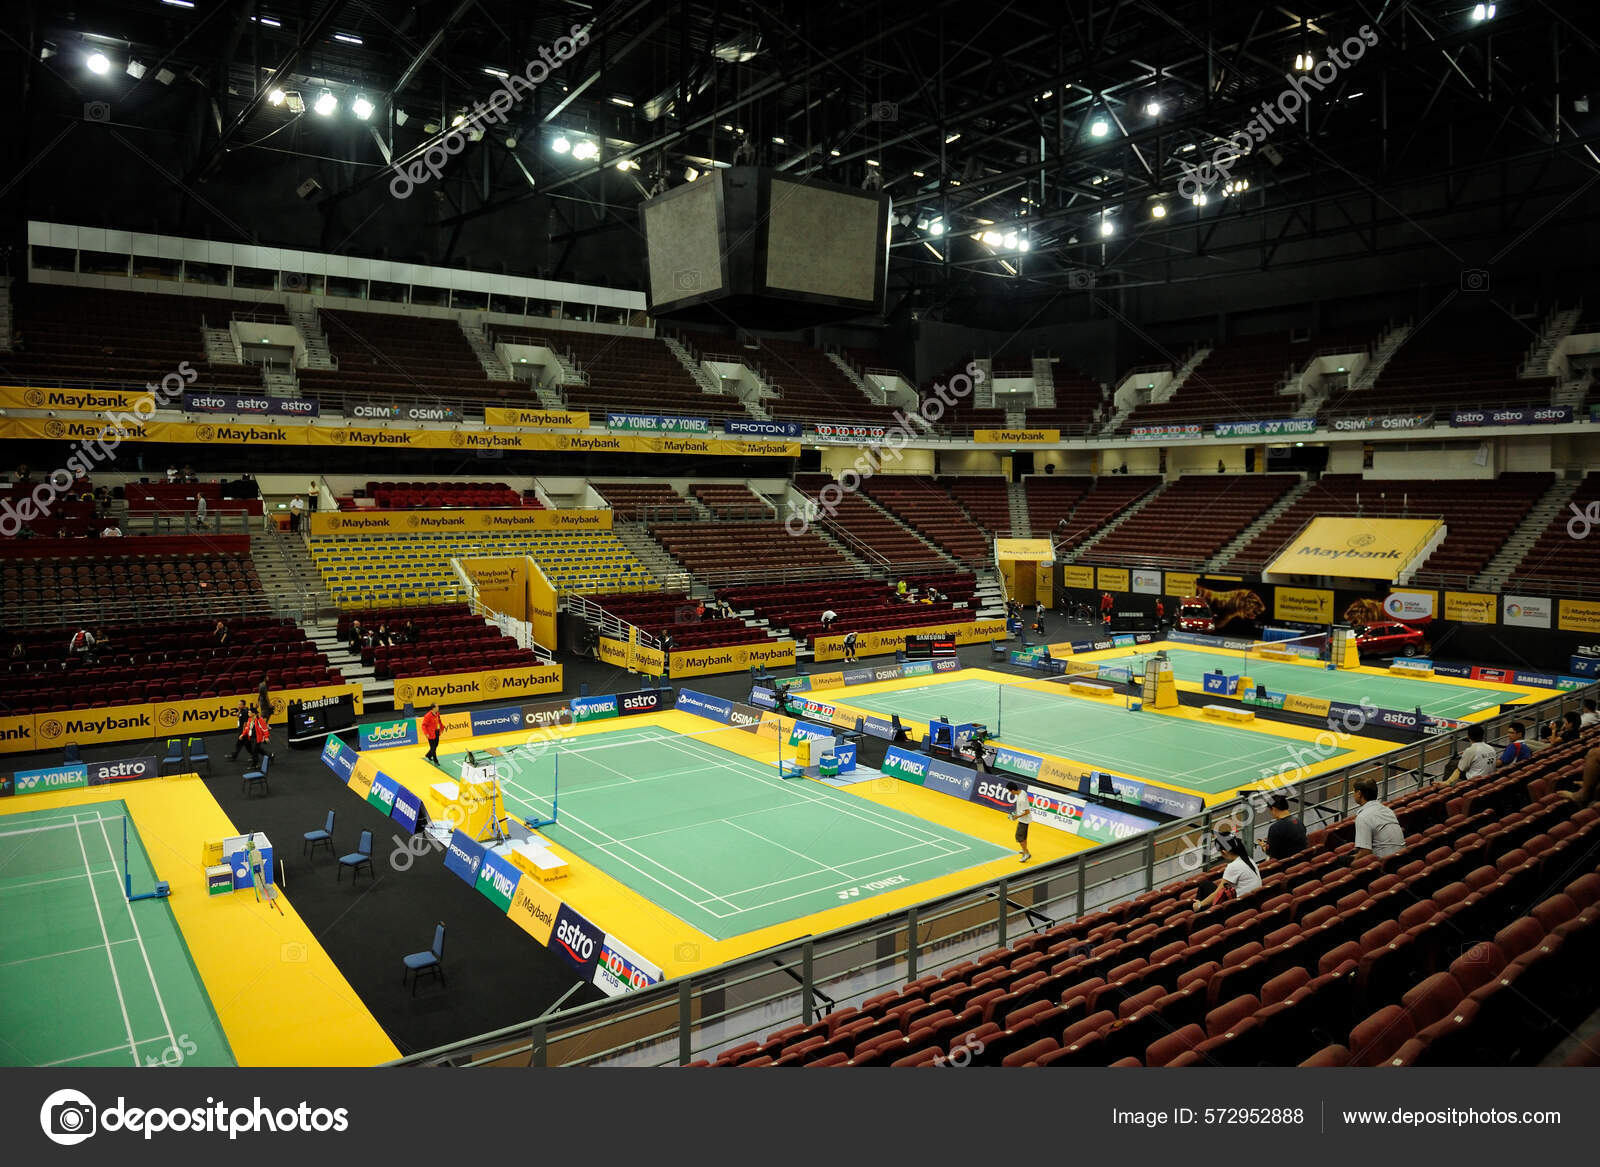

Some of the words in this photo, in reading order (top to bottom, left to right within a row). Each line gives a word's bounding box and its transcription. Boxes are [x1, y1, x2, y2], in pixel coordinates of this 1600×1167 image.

[48, 393, 128, 408] Maybank
[192, 398, 225, 408] astro
[236, 399, 268, 409] astro
[281, 400, 312, 411] astro
[354, 407, 390, 417] OSIM
[409, 409, 443, 419] OSIM
[520, 414, 572, 425] Maybank
[1456, 413, 1484, 422] astro
[1493, 411, 1523, 421] astro
[1534, 410, 1565, 419] astro
[628, 418, 657, 428] YONEX
[678, 419, 706, 431] YONEX
[730, 424, 785, 433] PROTON
[1233, 424, 1261, 434] YONEX
[1284, 421, 1313, 432] YONEX
[1336, 420, 1365, 430] OSIM
[1382, 418, 1414, 428] OSIM
[68, 424, 148, 439] Maybank
[217, 428, 286, 442] Maybank
[350, 431, 411, 444] Maybank
[467, 435, 522, 447] Maybank
[571, 438, 620, 449] Maybank
[664, 442, 708, 452] Maybank
[748, 444, 787, 454] Maybank
[1002, 432, 1044, 442] Maybank
[342, 518, 390, 528] Maybank
[420, 517, 464, 526] Maybank
[493, 516, 534, 526] Maybank
[561, 515, 599, 524] Maybank
[1296, 546, 1402, 560] Maybank
[880, 636, 906, 647] Mayba
[975, 625, 1005, 635] Maybank
[602, 644, 626, 661] Maybank
[636, 651, 662, 668] Maybank
[686, 653, 732, 668] Maybank
[749, 648, 794, 661] Maybank
[937, 661, 955, 669] astro
[1433, 666, 1461, 674] PROTON
[876, 670, 898, 680] OSIM
[1517, 675, 1553, 685] SAMSUNG
[416, 681, 480, 697] Maybank
[502, 673, 560, 688] Maybank
[302, 697, 339, 711] SAMSUNG
[589, 702, 616, 714] YONEX
[624, 694, 657, 708] astro
[1296, 700, 1328, 712] Maybank
[704, 703, 724, 714] PROTON
[807, 700, 818, 712] 100
[821, 705, 834, 717] 100
[65, 714, 150, 734] Maybank
[474, 717, 510, 727] PROTON
[526, 710, 560, 724] OSIM
[731, 711, 754, 725] OSIM
[1384, 712, 1416, 726] astro
[443, 720, 470, 733] ybank
[768, 720, 792, 734] Mayank
[864, 722, 888, 732] PROTON
[98, 762, 146, 779] astro
[900, 758, 924, 776] YONEX
[1013, 756, 1039, 772] YONEX
[43, 771, 83, 786] YONEX
[928, 770, 962, 785] PROTON
[379, 784, 395, 806] YONEX
[978, 780, 1018, 804] astro
[1032, 793, 1051, 811] 100
[1056, 800, 1076, 818] 100
[1144, 794, 1184, 809] PROTON
[395, 796, 416, 822] SAMSUNG
[1054, 815, 1073, 825] PLUS
[450, 844, 472, 866] PROTON
[492, 870, 515, 900] YONEX
[861, 874, 910, 892] YONEX
[522, 896, 553, 928] Maybank
[556, 918, 594, 960] astro
[606, 950, 625, 976] 100
[602, 970, 619, 989] PLUS
